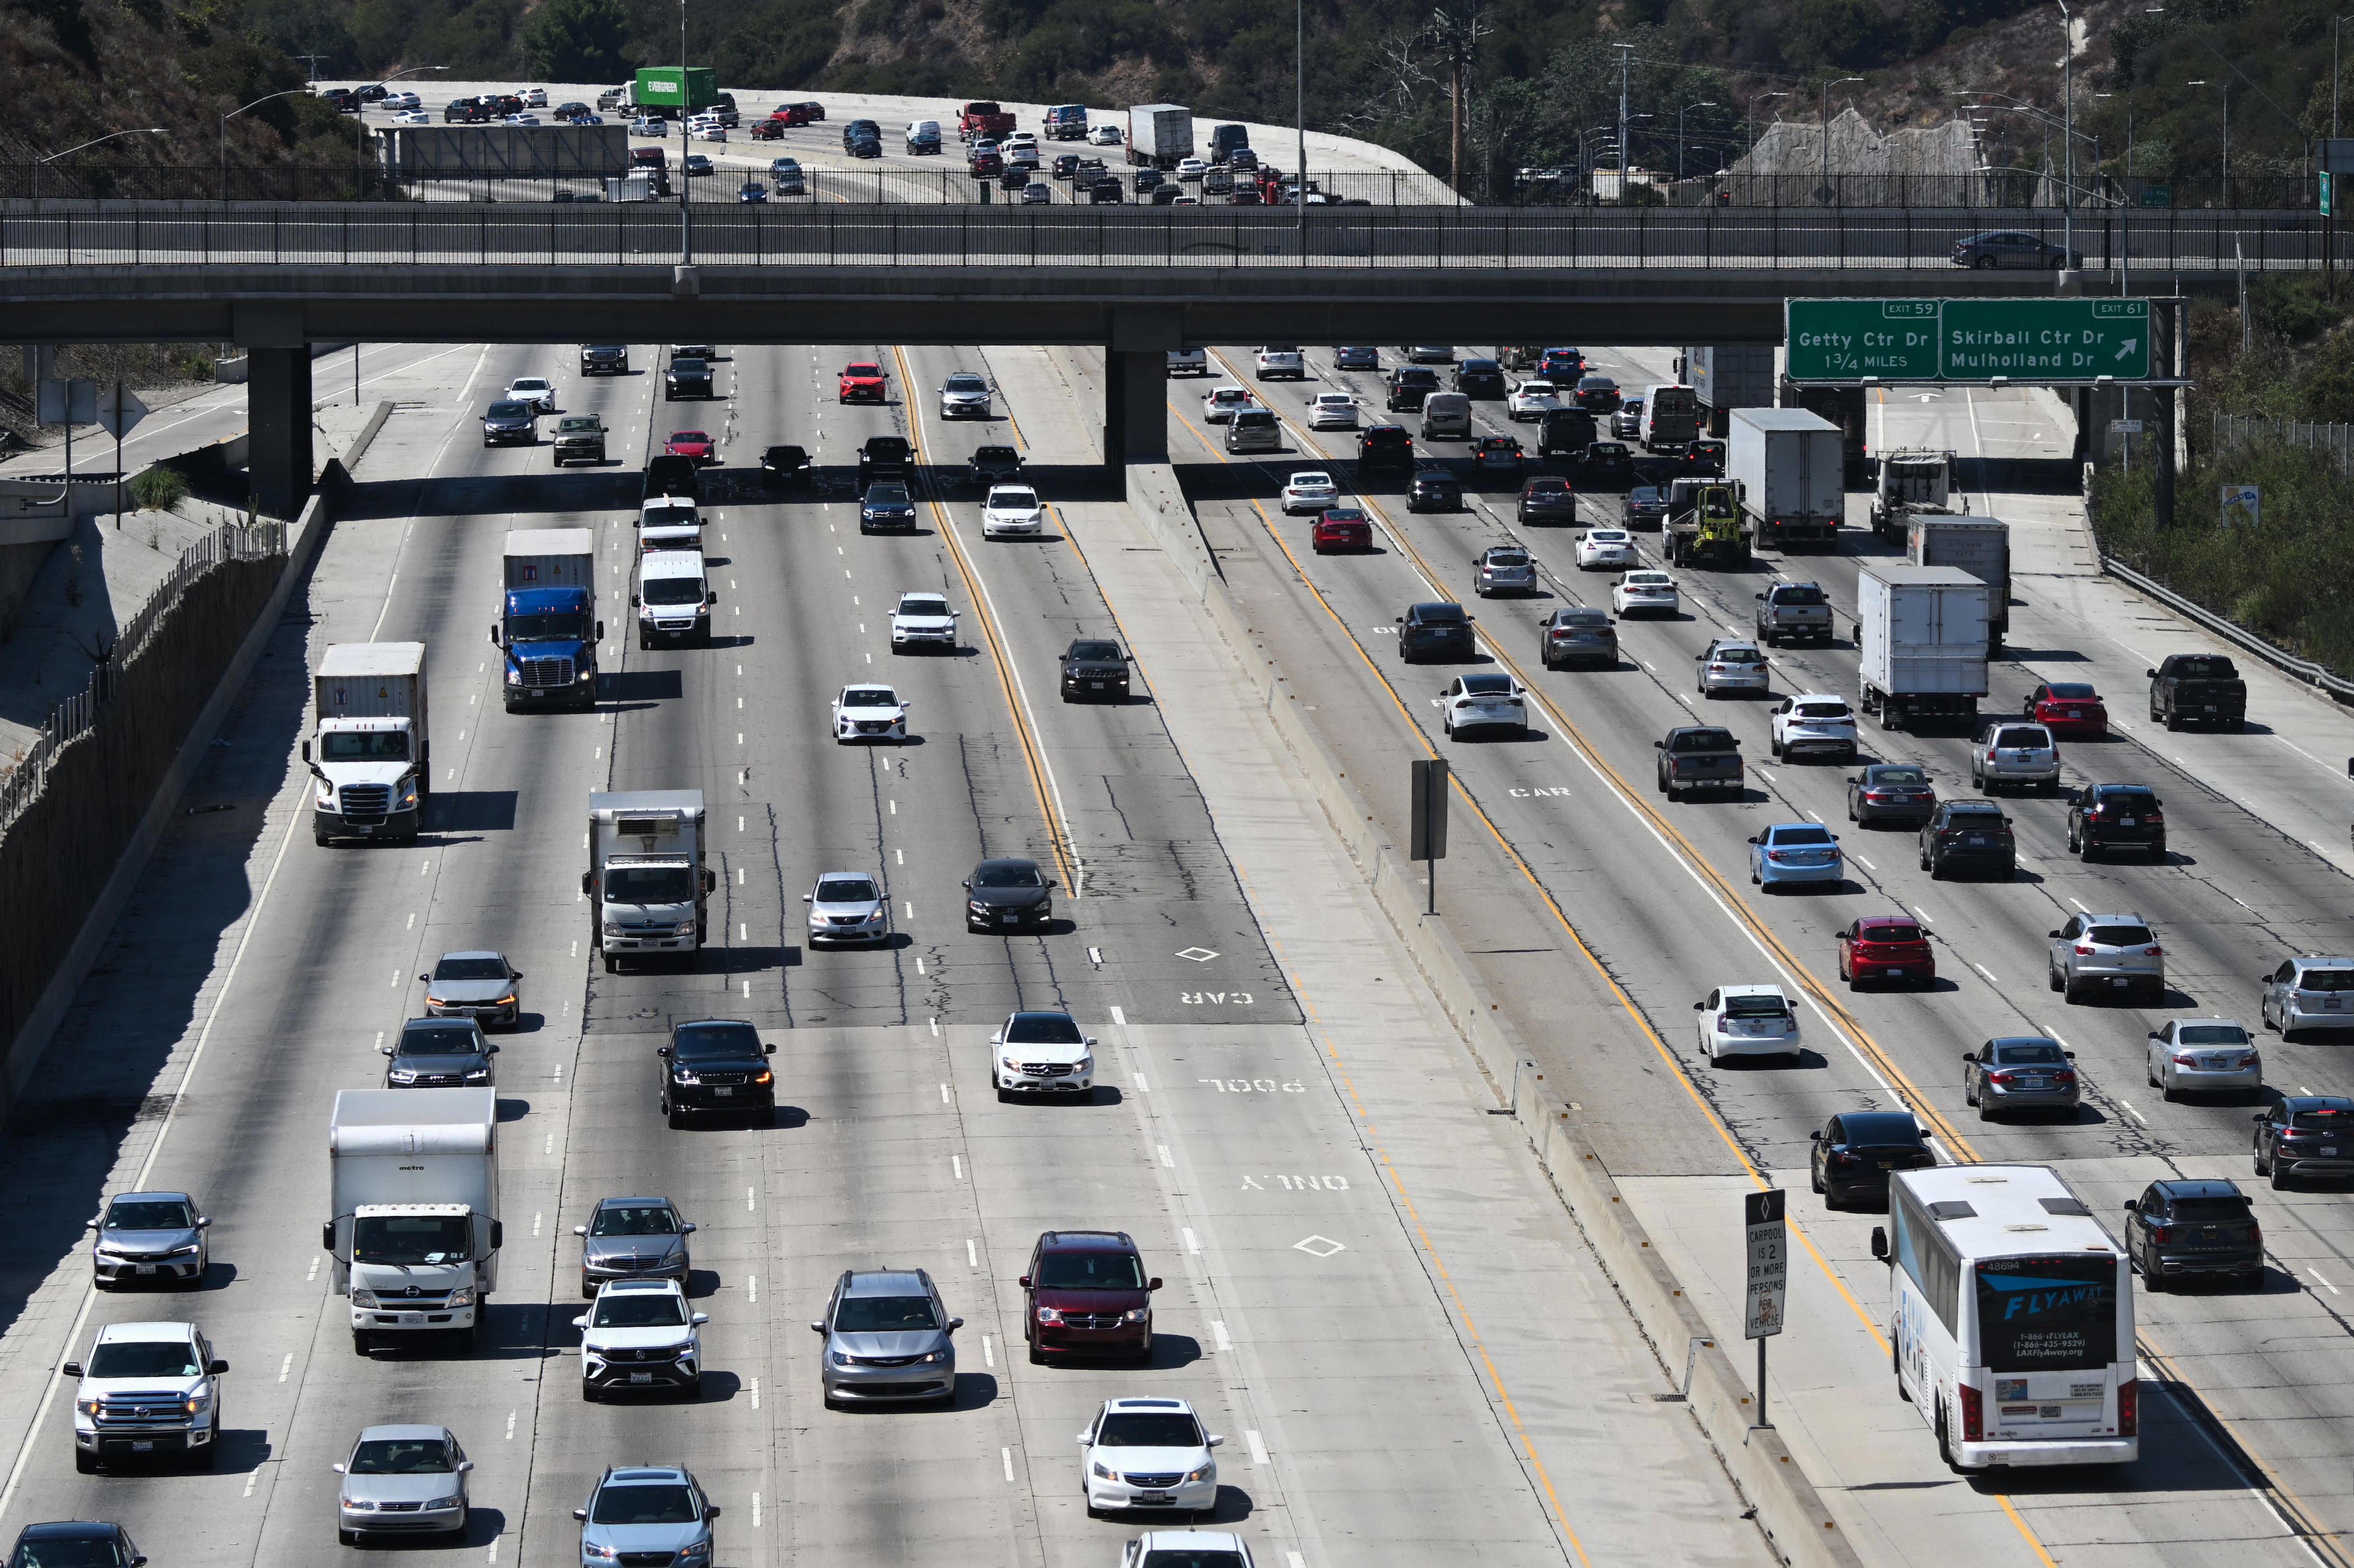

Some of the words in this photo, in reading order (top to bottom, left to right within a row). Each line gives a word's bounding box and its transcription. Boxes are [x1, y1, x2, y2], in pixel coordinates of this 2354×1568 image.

[648, 81, 678, 93] EVERGREEN
[1916, 304, 1933, 314] 59
[2127, 304, 2141, 313] 61
[1799, 333, 1852, 349] Getty
[1864, 332, 1894, 346] Ctr
[1907, 332, 1928, 346] Dr
[1953, 331, 2028, 344] Skirball
[2041, 331, 2071, 343] Ctr
[2083, 331, 2104, 343] Dr
[1865, 356, 1906, 366] MILES
[1952, 353, 2060, 366] Mulholland
[2073, 353, 2093, 366] Dr
[1509, 788, 1571, 797] CAR
[1181, 993, 1253, 1004] CAR
[1199, 1080, 1304, 1092] POOL
[1242, 1175, 1349, 1190] ONLY
[1750, 1228, 1782, 1243] CARPOOL
[1758, 1248, 1765, 1259] IS
[1769, 1245, 1776, 1259] 2
[1750, 1266, 1760, 1278] OR
[1764, 1263, 1784, 1277] MORE
[1987, 1261, 2019, 1270] 48694
[1750, 1280, 1783, 1296] PERSONS
[2004, 1287, 2102, 1320] FLYAWAY
[1750, 1314, 1779, 1329] VEHICLE
[2014, 1340, 2085, 1349] (1-866-435-9529)
